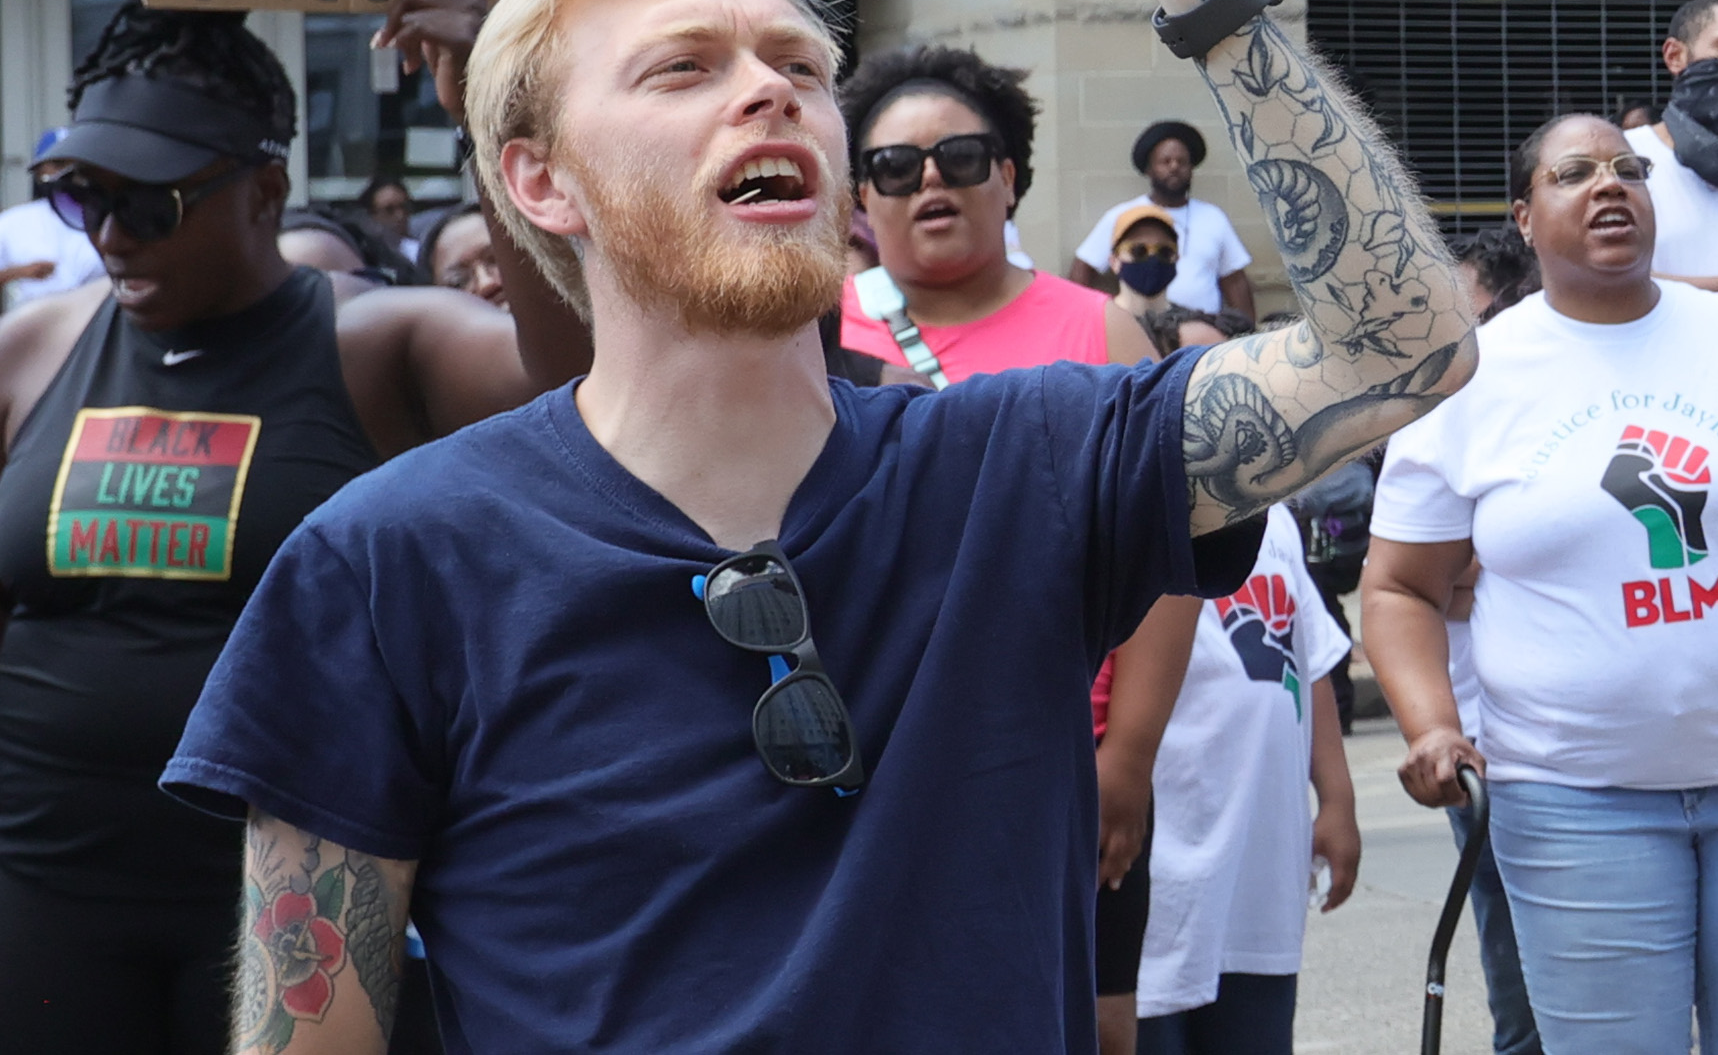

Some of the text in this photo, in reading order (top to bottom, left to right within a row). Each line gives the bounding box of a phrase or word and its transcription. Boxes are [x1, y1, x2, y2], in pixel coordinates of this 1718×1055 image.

[106, 417, 219, 458] BLACK
[1519, 403, 1602, 486] Justice
[1611, 390, 1656, 411] for
[97, 462, 200, 508] LIVES
[69, 518, 211, 568] MATTER
